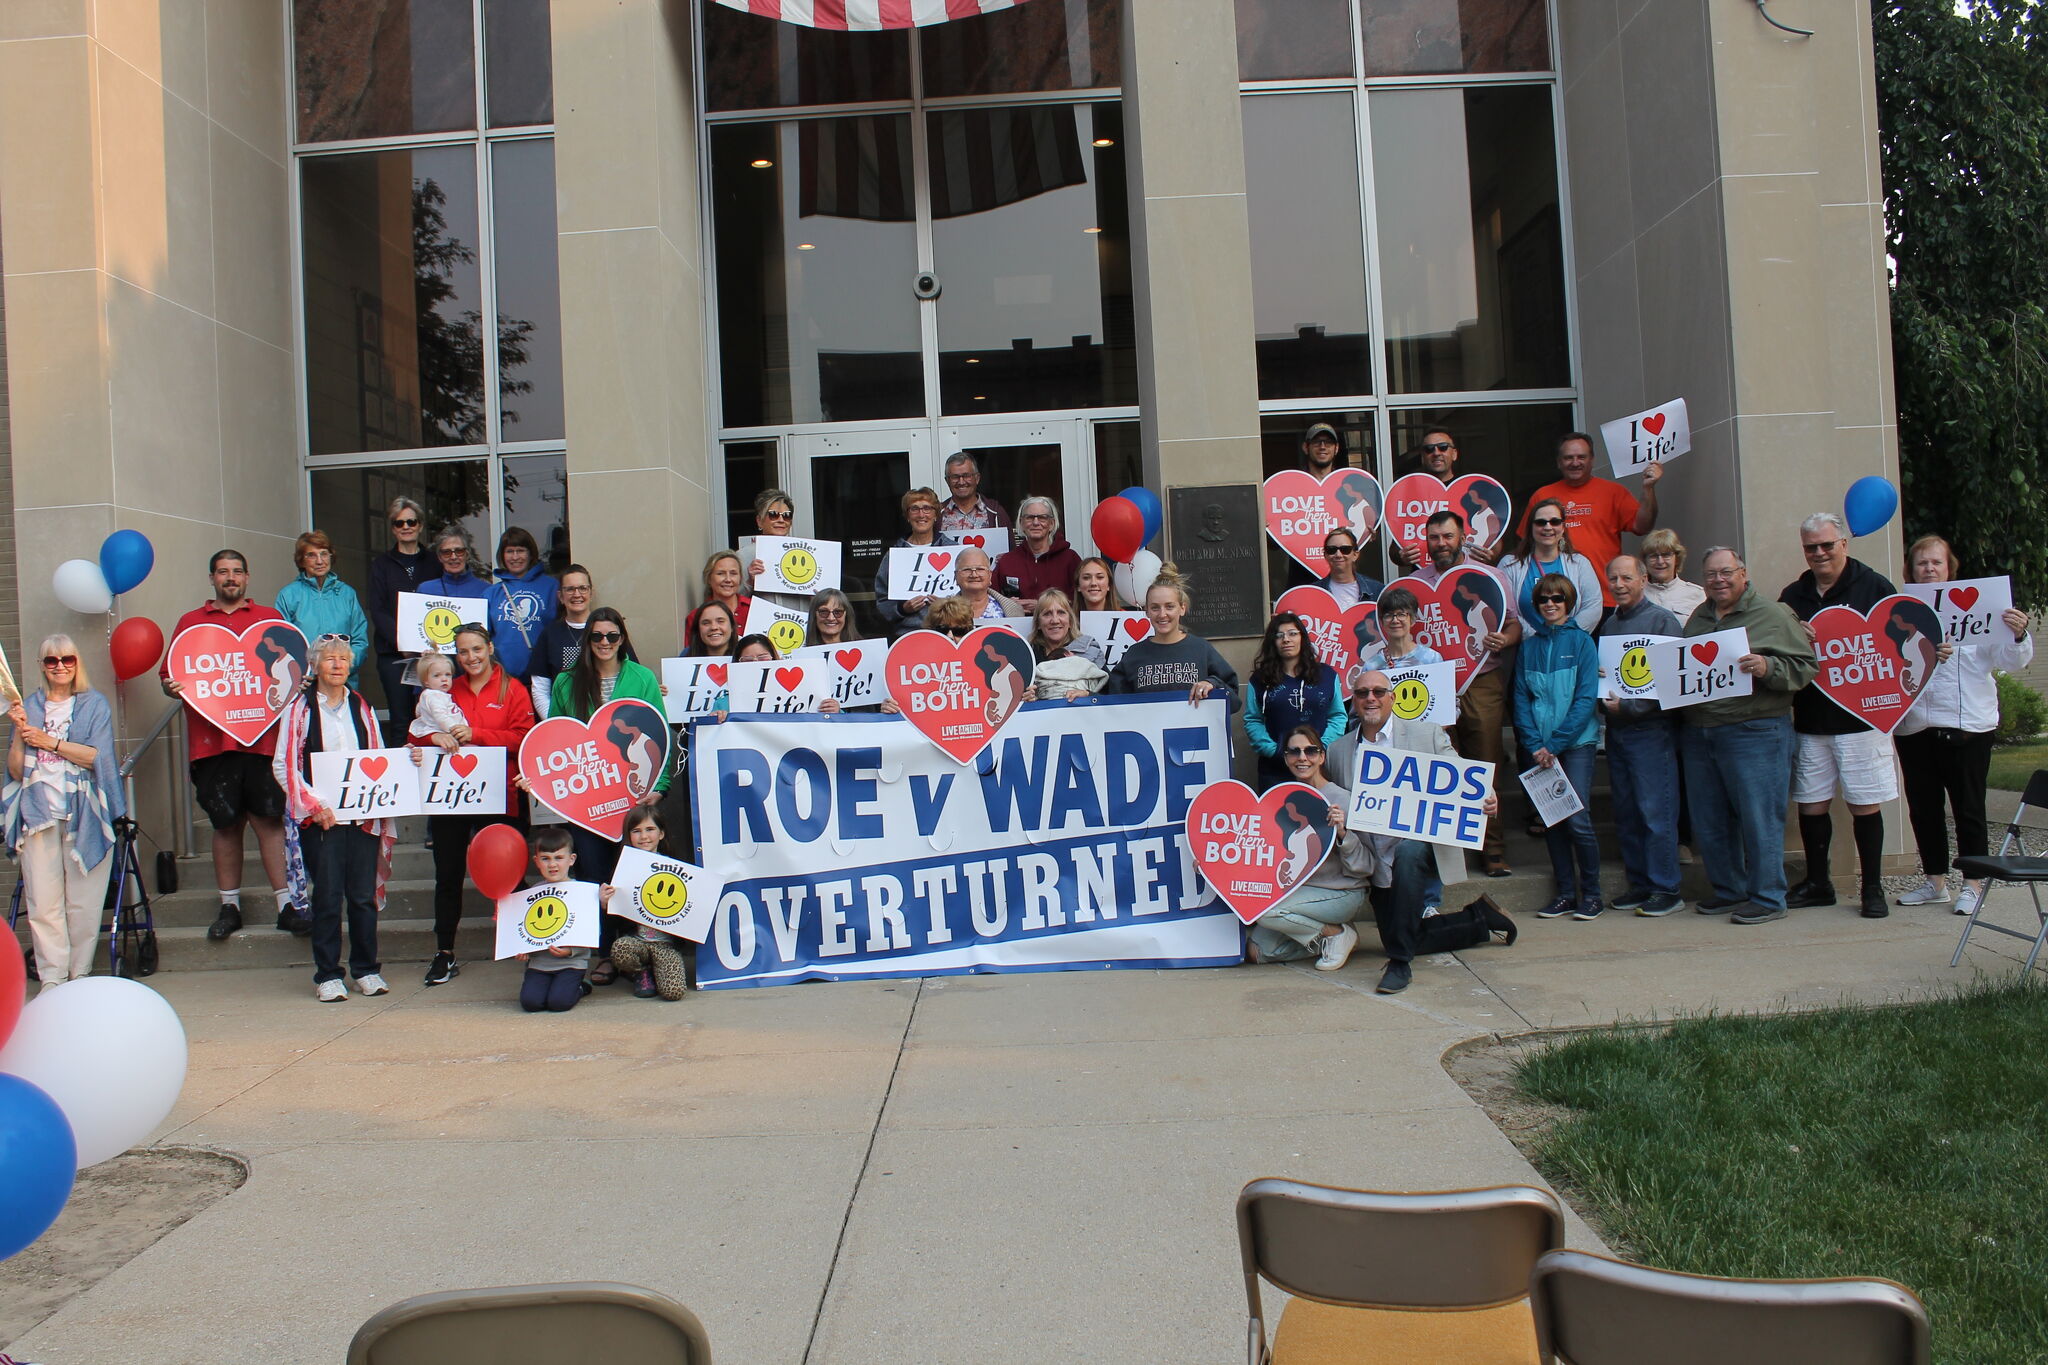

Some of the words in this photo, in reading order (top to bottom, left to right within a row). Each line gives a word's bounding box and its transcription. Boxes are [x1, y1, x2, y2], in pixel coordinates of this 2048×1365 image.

[1630, 420, 1639, 442] I
[1631, 432, 1676, 465] Life!
[1271, 496, 1325, 513] LOVE
[1296, 507, 1331, 520] them
[1281, 518, 1338, 535] BOTH
[782, 541, 817, 553] Smile!
[912, 552, 925, 572] I
[781, 579, 796, 590] Mom
[798, 581, 816, 591] Chose
[908, 574, 956, 595] Life!
[425, 600, 461, 612] Smile!
[1933, 588, 1944, 612] I
[1107, 618, 1120, 640] I
[1298, 615, 1342, 642] OVE
[1416, 617, 1451, 632] them
[1945, 613, 1991, 642] ife!
[1308, 631, 1343, 652] them
[1416, 625, 1460, 648] OTH
[1814, 633, 1876, 662] LOVE
[184, 652, 246, 674] LOVE
[1677, 646, 1687, 671] I
[1842, 649, 1884, 665] them
[212, 665, 253, 680] them
[689, 664, 703, 686] I
[757, 668, 771, 693] I
[900, 661, 963, 685] LOVE
[1137, 673, 1199, 688] MICHIGAN
[1138, 662, 1199, 679] CENTRAL
[1391, 670, 1429, 685] Smile!
[1678, 665, 1735, 697] Life!
[1828, 658, 1895, 687] BOTH
[195, 676, 261, 698] BOTH
[832, 673, 873, 703] ife!
[927, 676, 971, 692] them
[1621, 684, 1633, 695] Mom
[756, 694, 814, 713] Life!
[911, 688, 980, 712] BOTH
[430, 753, 446, 777] I
[536, 740, 599, 776] LOVE
[566, 757, 609, 775] them
[341, 757, 356, 783] I
[1360, 750, 1487, 801] DADS
[551, 763, 621, 800] BOTH
[717, 746, 884, 845] ROE
[908, 773, 956, 836] v
[975, 726, 1209, 833] WADE
[337, 783, 399, 814] Life!
[425, 781, 487, 809] Life!
[1200, 812, 1261, 836] LOVE
[1355, 790, 1387, 812] for
[1389, 795, 1482, 843] LIFE
[1225, 829, 1267, 847] them
[1205, 841, 1275, 867] BOTH
[650, 862, 694, 883] Smile!
[526, 887, 568, 905] Smile!
[633, 885, 641, 906] Your
[637, 907, 653, 923] Mom
[655, 917, 681, 926] Chose
[680, 901, 694, 918] Life!
[518, 921, 526, 938] Your
[525, 937, 543, 946] Mom
[545, 930, 568, 945] Chose
[566, 912, 576, 929] Life!
